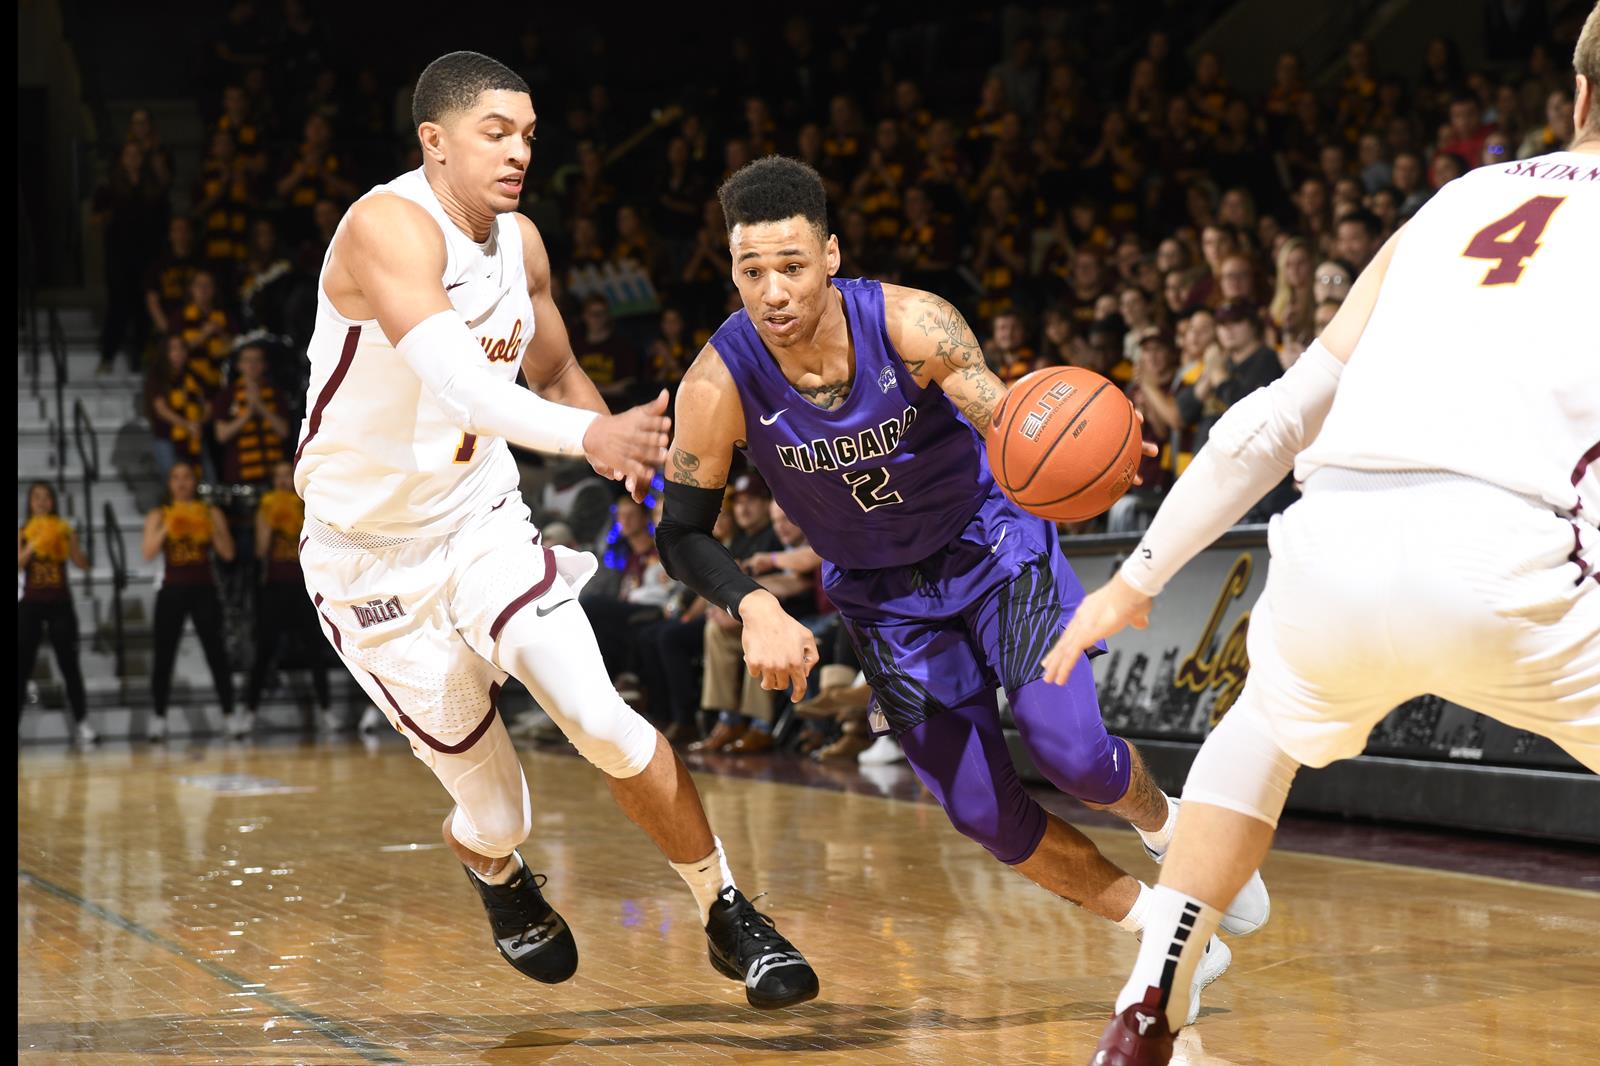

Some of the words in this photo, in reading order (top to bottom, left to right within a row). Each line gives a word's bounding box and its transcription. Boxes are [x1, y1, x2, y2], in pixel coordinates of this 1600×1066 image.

[1460, 194, 1568, 286] 4
[1019, 380, 1074, 440] ELITE
[842, 466, 904, 513] 2
[350, 595, 407, 629] VALLEY
